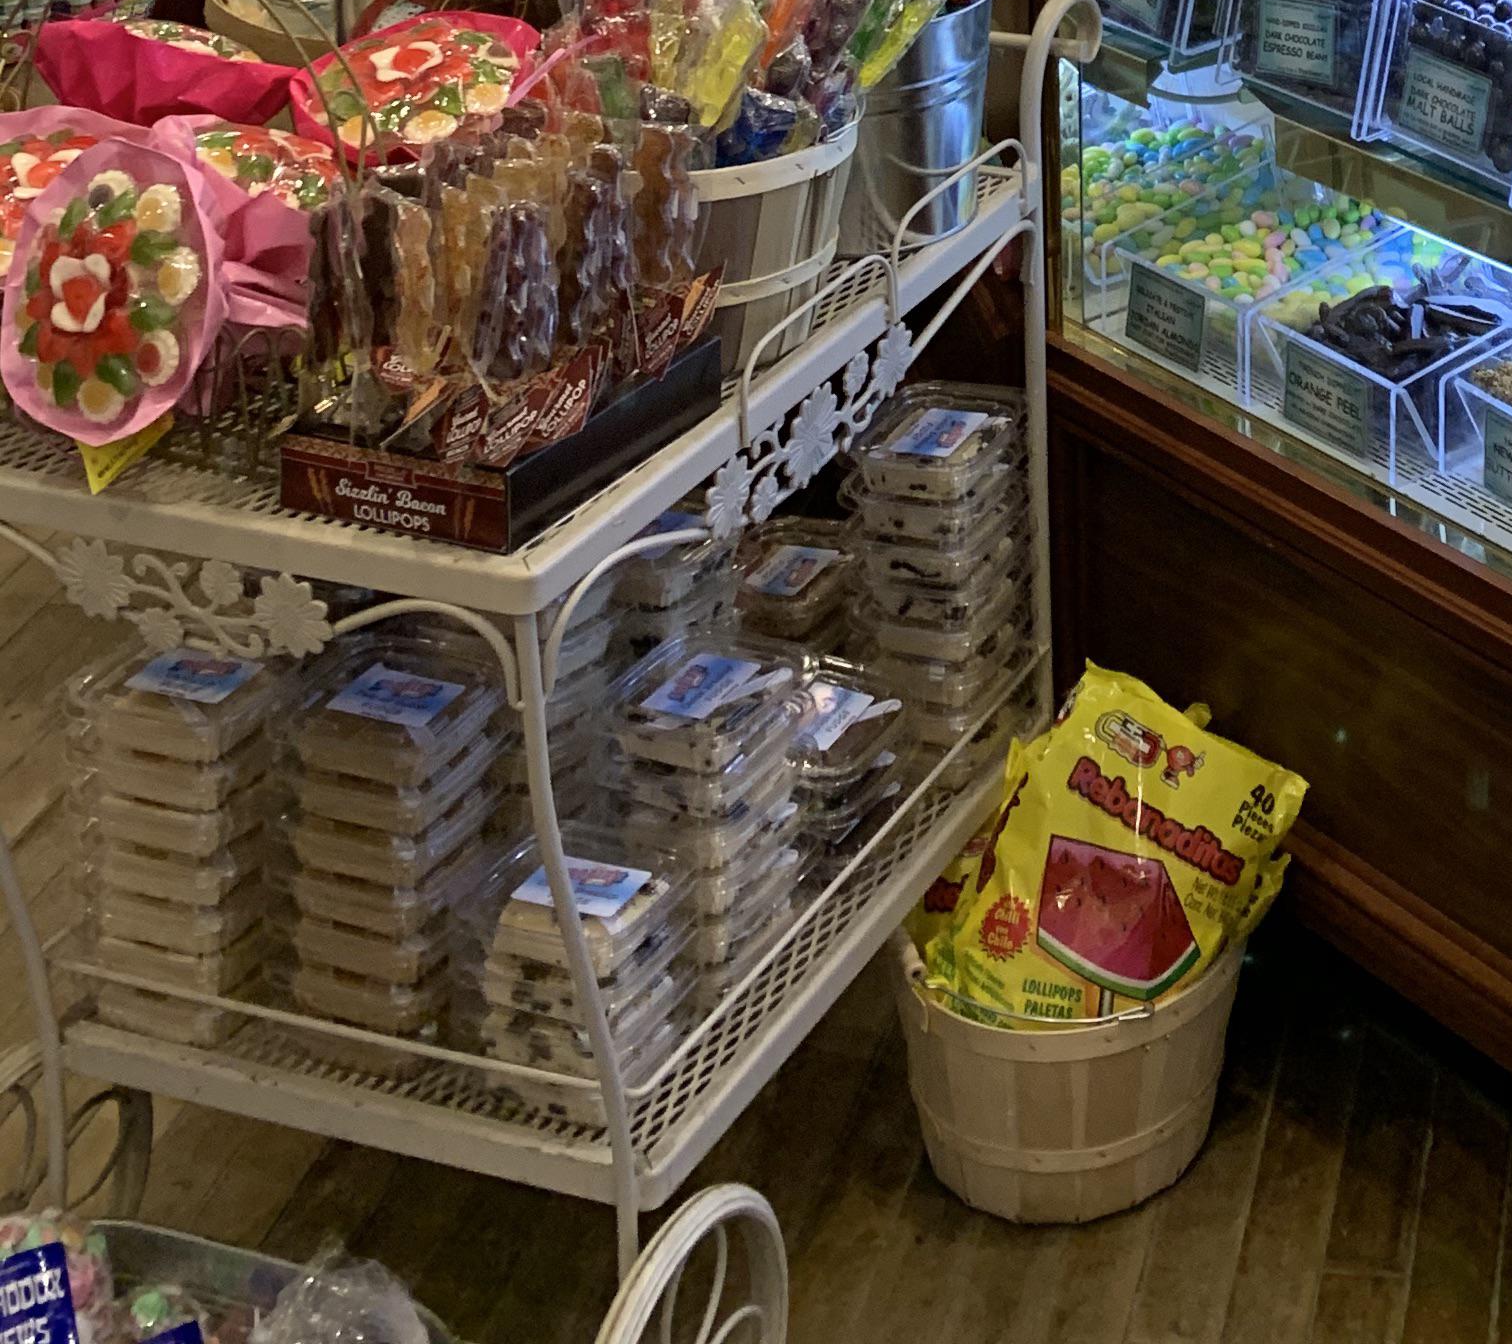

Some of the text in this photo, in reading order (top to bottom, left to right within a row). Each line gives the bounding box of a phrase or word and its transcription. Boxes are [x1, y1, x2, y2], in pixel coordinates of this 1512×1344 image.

[1263, 41, 1304, 58] ESPRESSO
[1284, 32, 1326, 50] CHOCOLATE
[1406, 96, 1474, 136] MALT BALLS
[1410, 85, 1477, 120] DARK CHOCOLATE
[335, 477, 447, 516] Sizzlin' Bacon
[353, 504, 430, 532] LOLLIPOPS
[1250, 783, 1276, 816] 40
[1022, 979, 1082, 1003] LOLLIPOPS
[1024, 999, 1074, 1019] PALETAS
